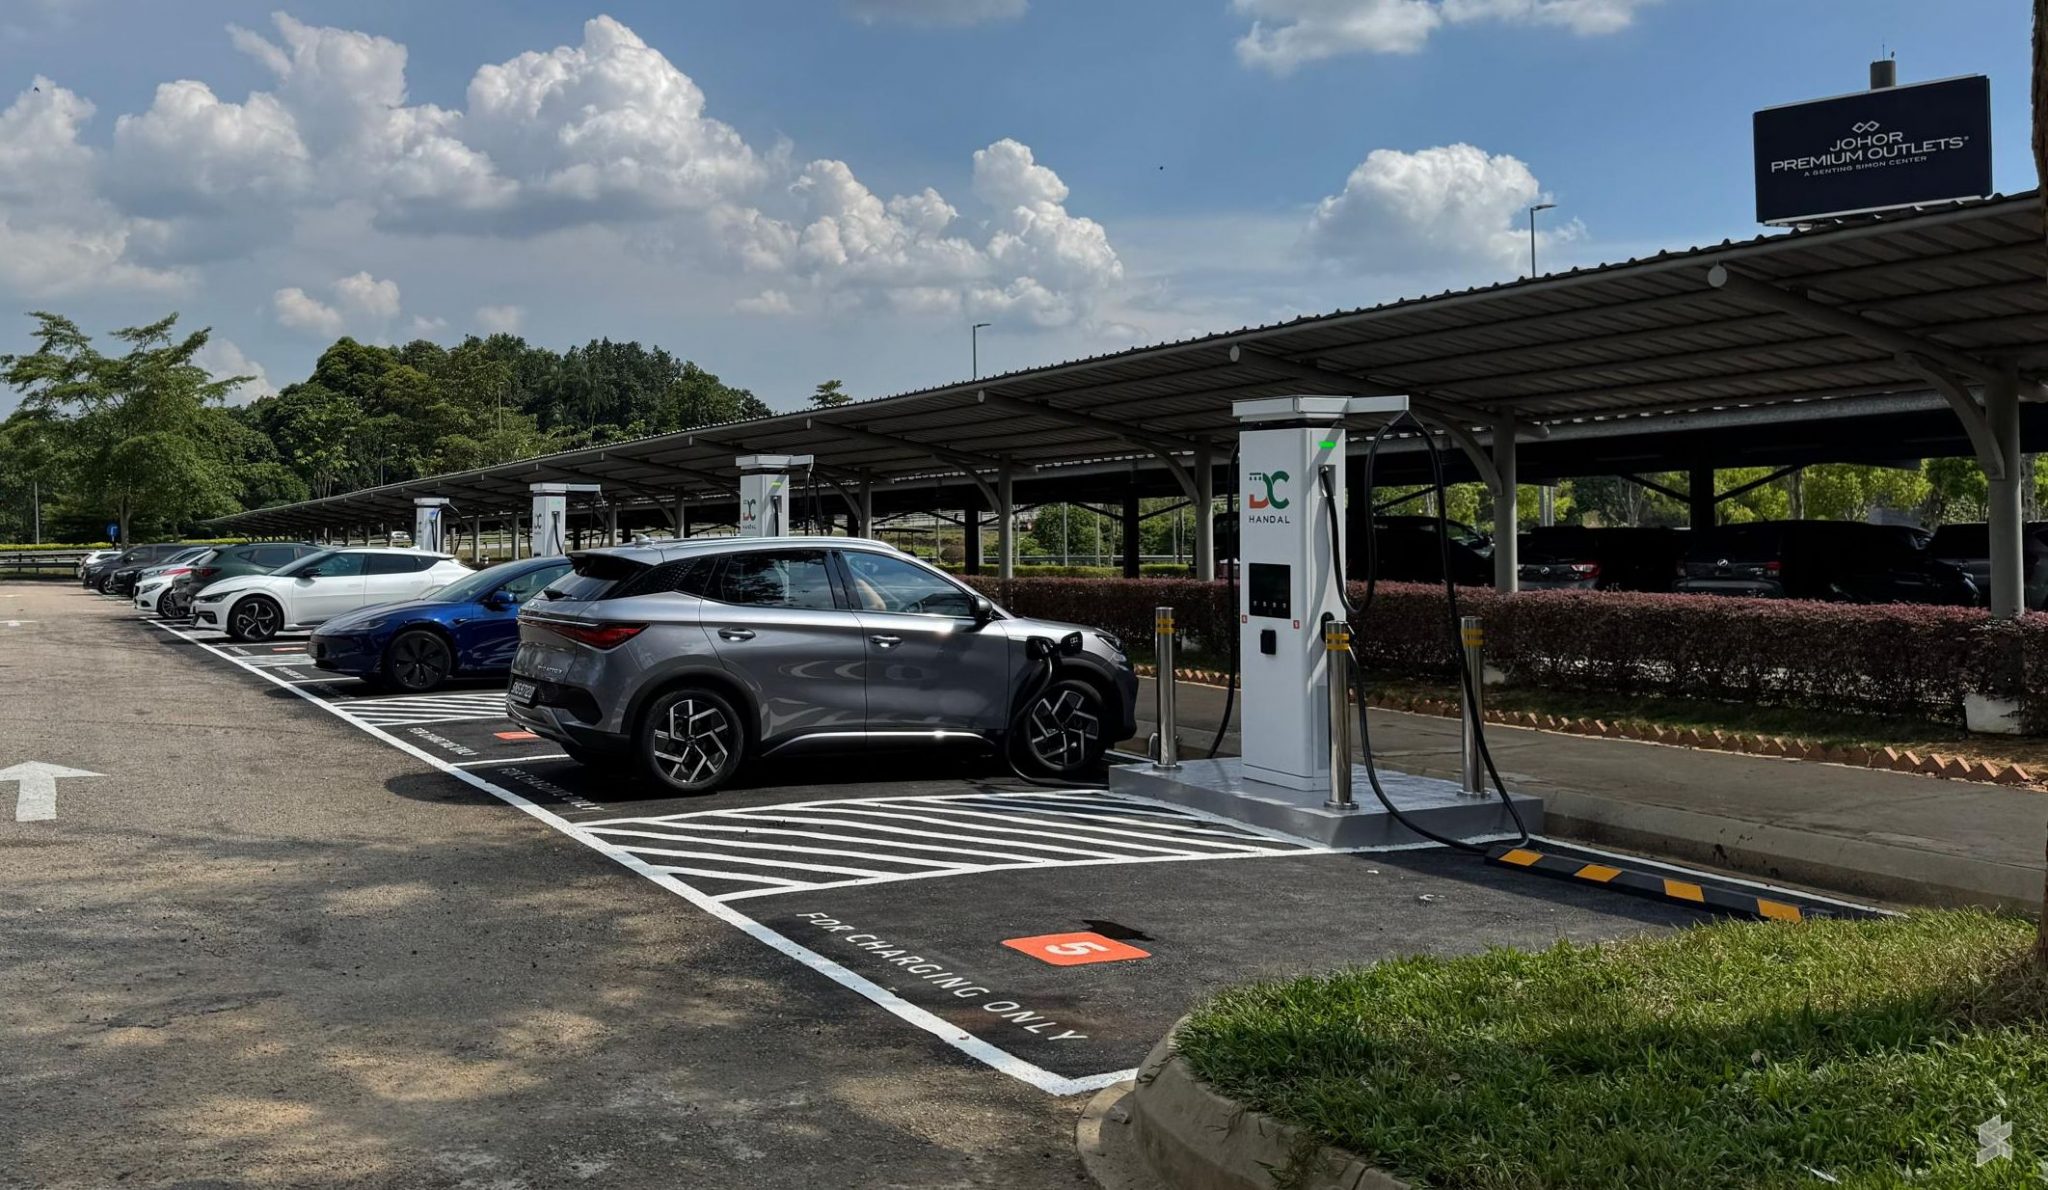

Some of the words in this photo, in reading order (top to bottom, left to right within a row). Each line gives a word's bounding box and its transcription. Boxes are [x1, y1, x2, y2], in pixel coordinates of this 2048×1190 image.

[1829, 131, 1904, 152] JOHOR
[1771, 150, 1863, 173] PREMIUM
[1812, 165, 1853, 176] GENTING
[1855, 161, 1886, 171] SIMON
[1888, 155, 1928, 166] CENTER
[1248, 515, 1291, 524] HANDAL
[1045, 940, 1111, 957] 5
[796, 911, 855, 933] FOR
[845, 933, 991, 999] CHARGING
[983, 1000, 1088, 1042] ONLY
